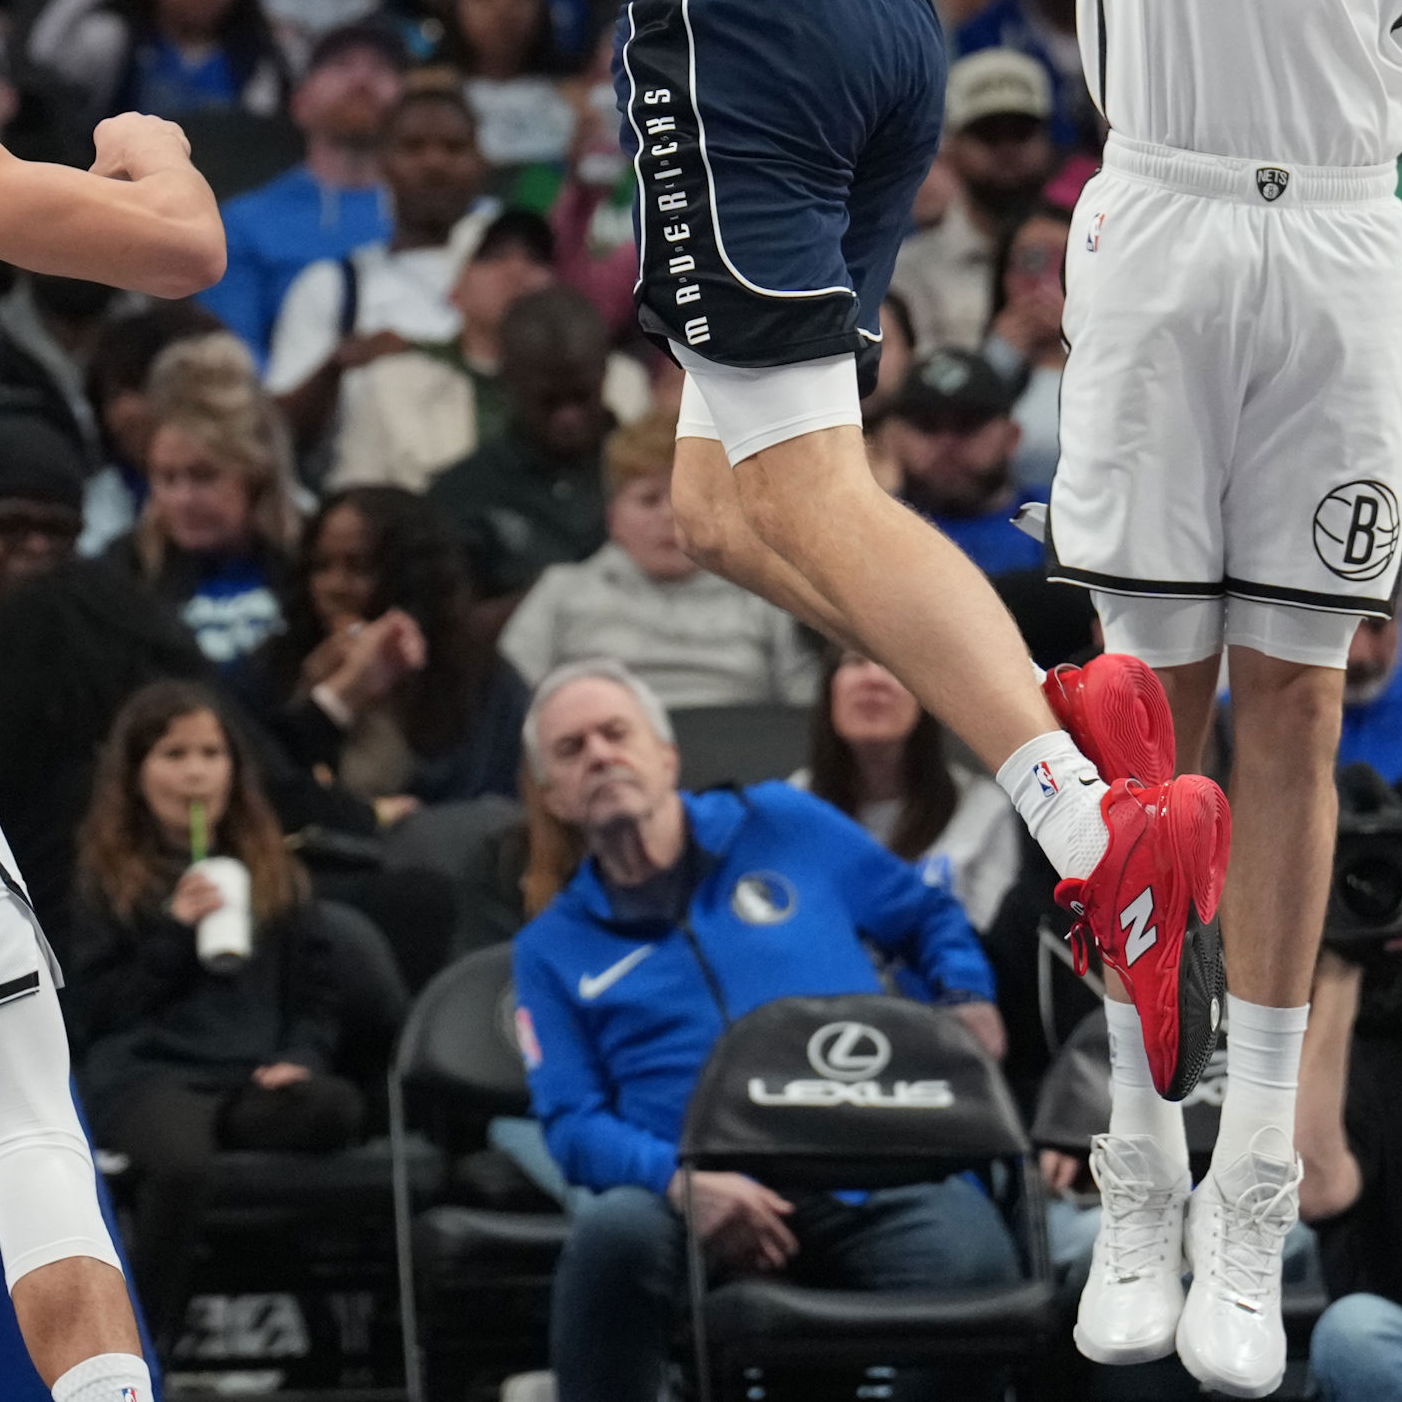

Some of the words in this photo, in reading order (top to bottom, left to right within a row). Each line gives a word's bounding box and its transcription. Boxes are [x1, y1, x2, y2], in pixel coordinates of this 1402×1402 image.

[1258, 169, 1288, 185] NETS
[644, 89, 711, 346] MAVERICKS
[1343, 495, 1378, 565] B
[748, 1077, 956, 1109] LEXUS
